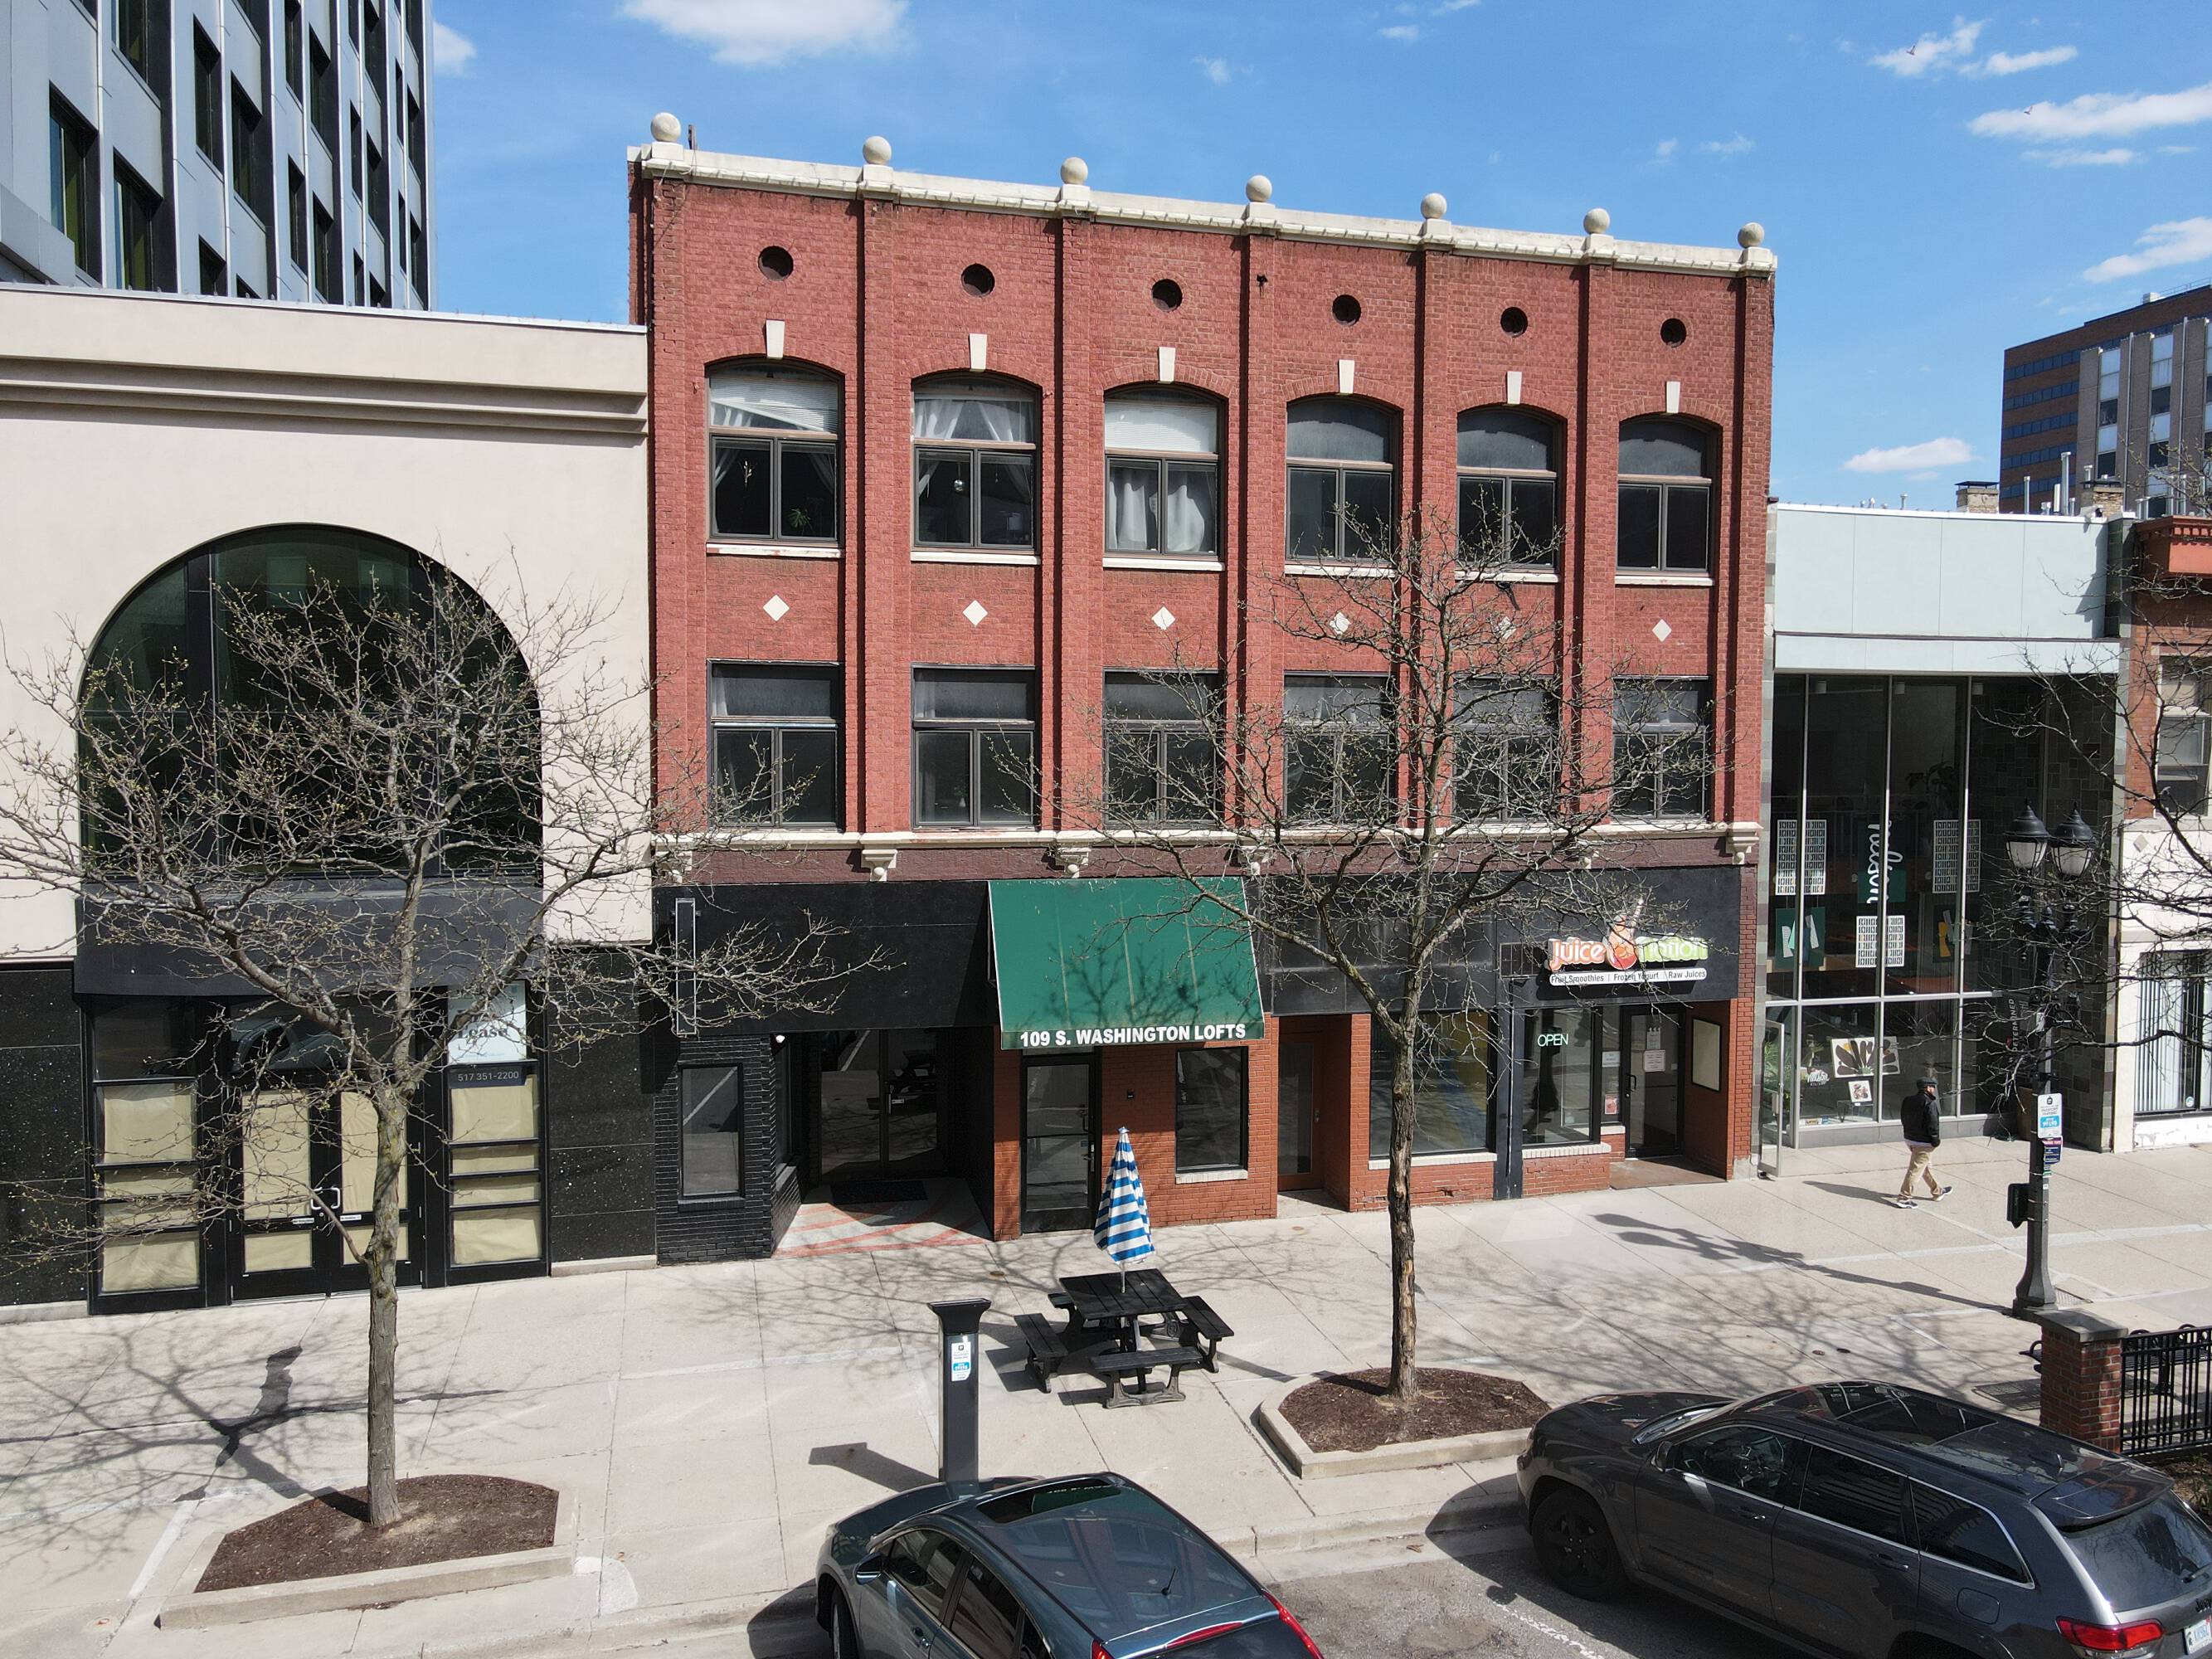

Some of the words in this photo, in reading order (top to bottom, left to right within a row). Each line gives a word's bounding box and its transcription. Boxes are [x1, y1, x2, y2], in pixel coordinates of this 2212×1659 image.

[1550, 941, 1605, 970] Juice
[1568, 974, 1604, 984] Smoothies
[1613, 973, 1636, 981] Frozen
[1668, 971, 1683, 979] Raw
[1685, 970, 1706, 978] Juices
[1020, 1031, 1050, 1047] 109
[1055, 1030, 1072, 1046] S.
[1076, 1026, 1189, 1044] WASHINGTON
[1194, 1024, 1246, 1039] LOFTS
[1537, 1034, 1569, 1047] OPEN
[457, 1073, 474, 1082] 517
[476, 1071, 519, 1080] 351-2200
